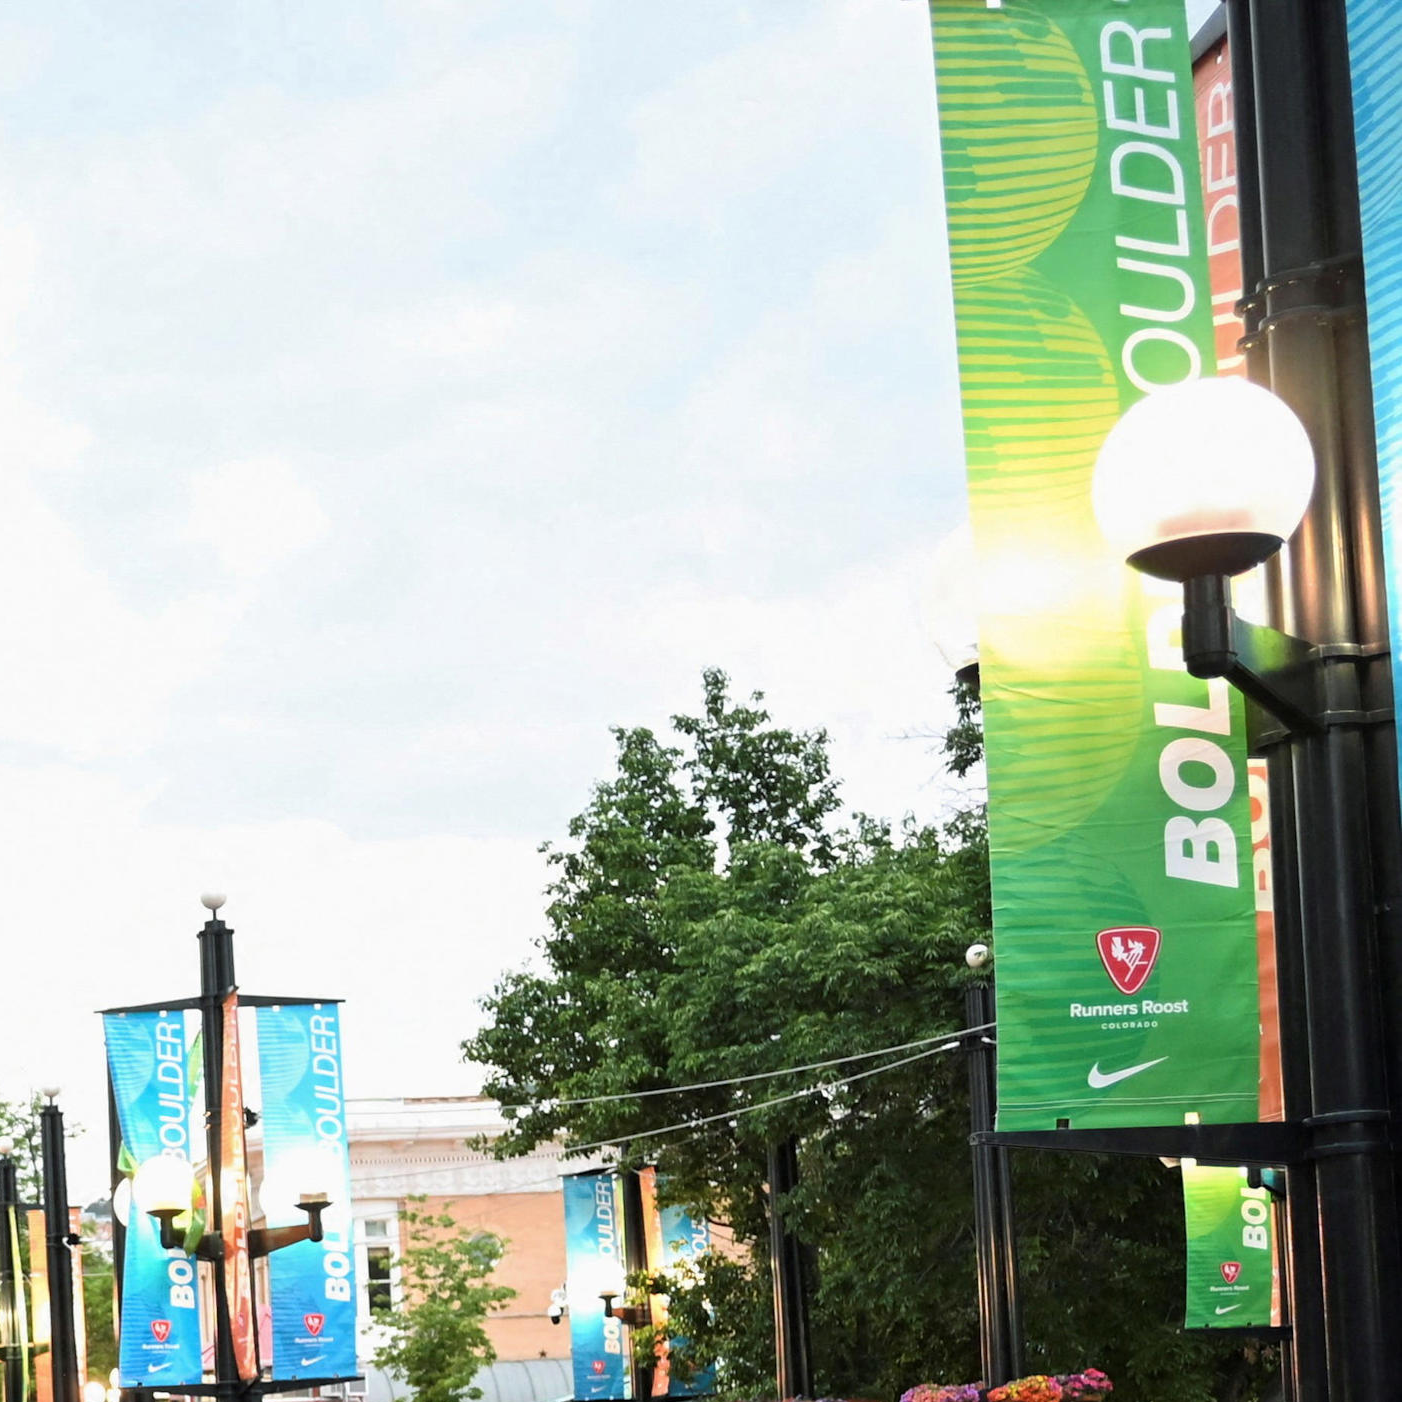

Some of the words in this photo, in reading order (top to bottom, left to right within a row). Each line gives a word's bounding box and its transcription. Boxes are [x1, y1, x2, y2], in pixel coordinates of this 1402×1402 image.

[1100, 20, 1202, 395] OULDER
[1069, 1002, 1138, 1018] Runners
[1141, 999, 1188, 1015] Roost
[1100, 1020, 1158, 1030] COLORADO
[595, 1181, 615, 1257] OULDER
